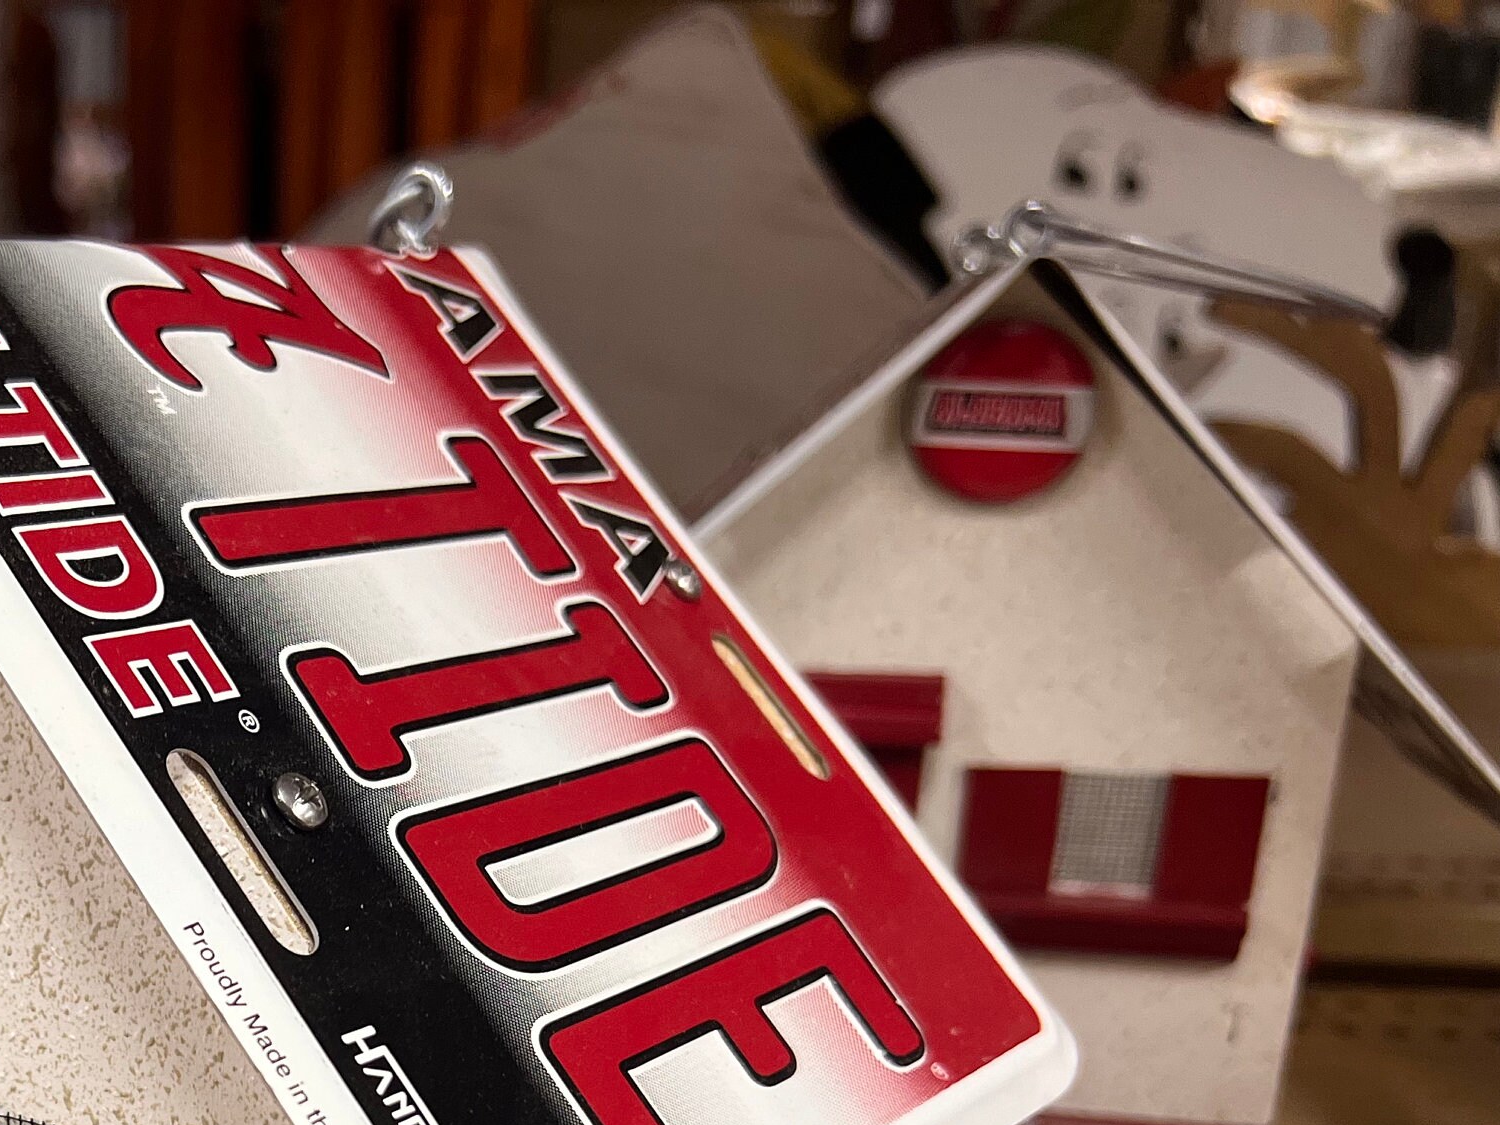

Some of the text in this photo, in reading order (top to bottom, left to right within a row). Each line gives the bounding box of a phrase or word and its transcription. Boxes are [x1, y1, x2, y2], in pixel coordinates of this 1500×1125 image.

[183, 921, 247, 1009] Proudly
[243, 1013, 291, 1078] Made
[288, 1081, 309, 1106] in
